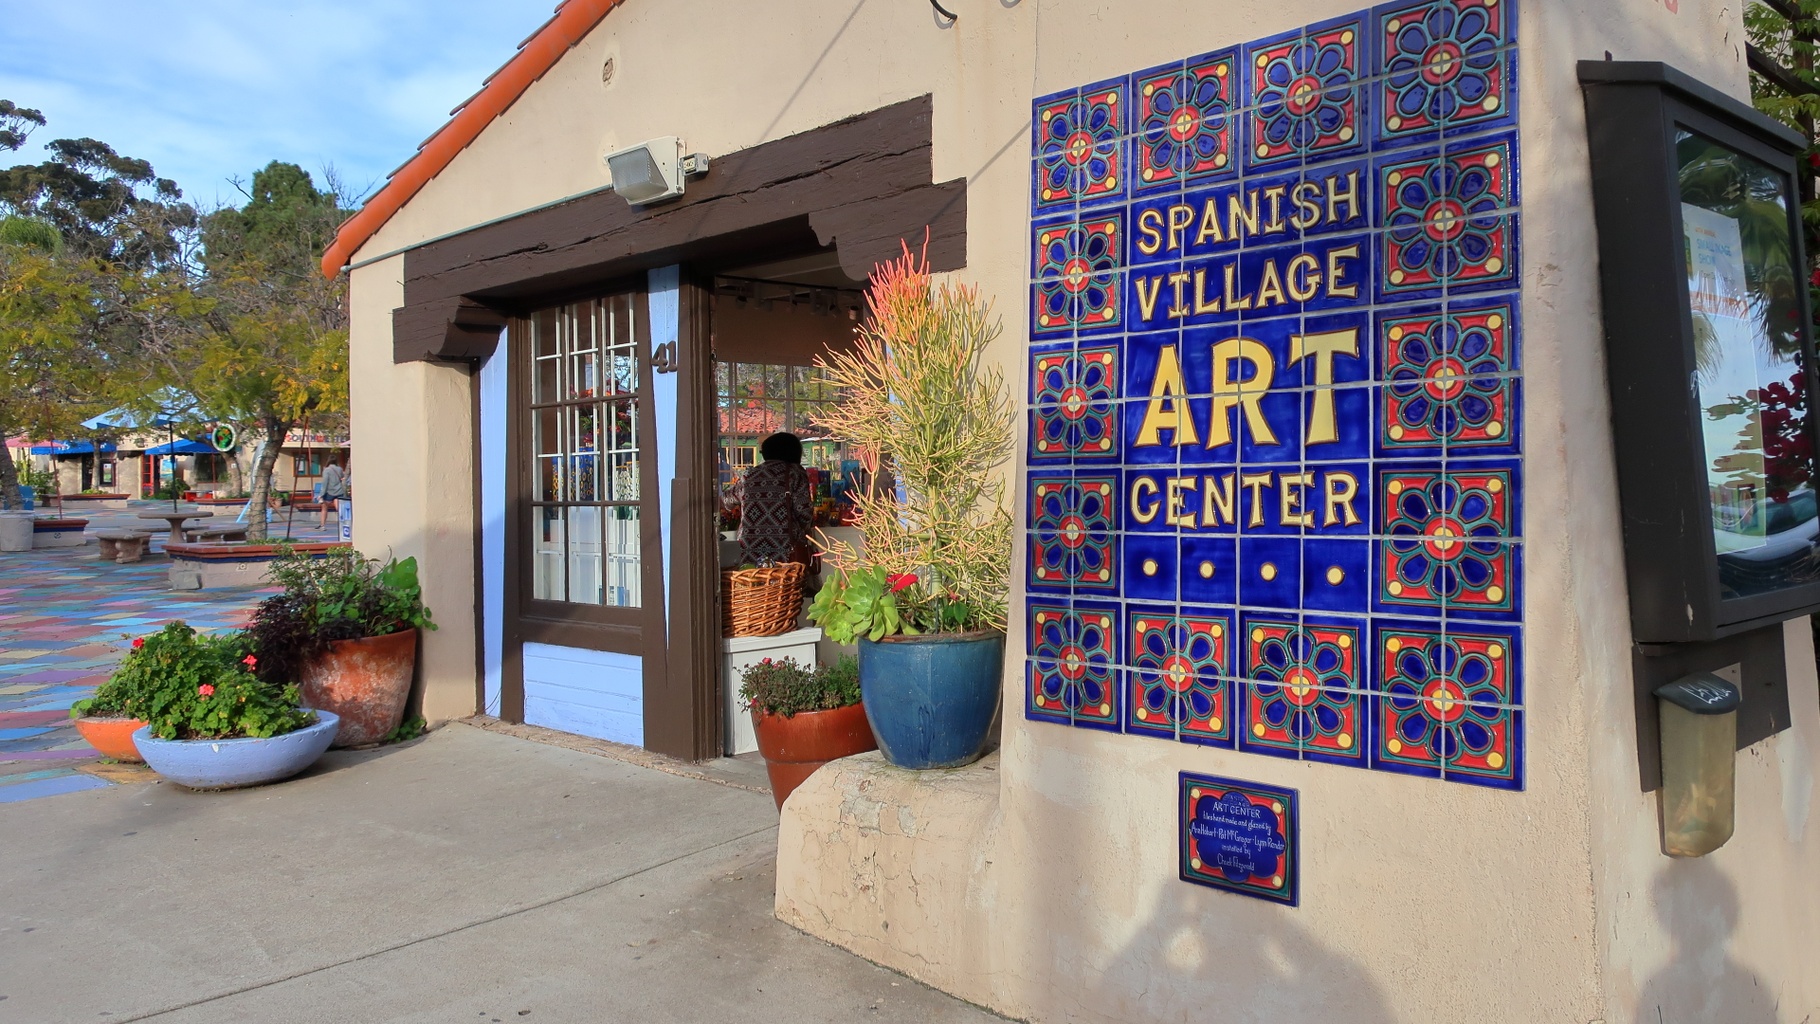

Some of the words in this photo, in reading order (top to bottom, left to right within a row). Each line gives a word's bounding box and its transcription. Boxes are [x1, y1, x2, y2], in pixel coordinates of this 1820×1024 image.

[1135, 168, 1361, 256] SPANISH
[1134, 243, 1361, 322] VILLAGE
[650, 340, 677, 374] 41
[1133, 326, 1360, 450] ART
[1130, 470, 1362, 530] CENTER
[1212, 801, 1229, 813] ART
[1229, 805, 1261, 819] CENTER
